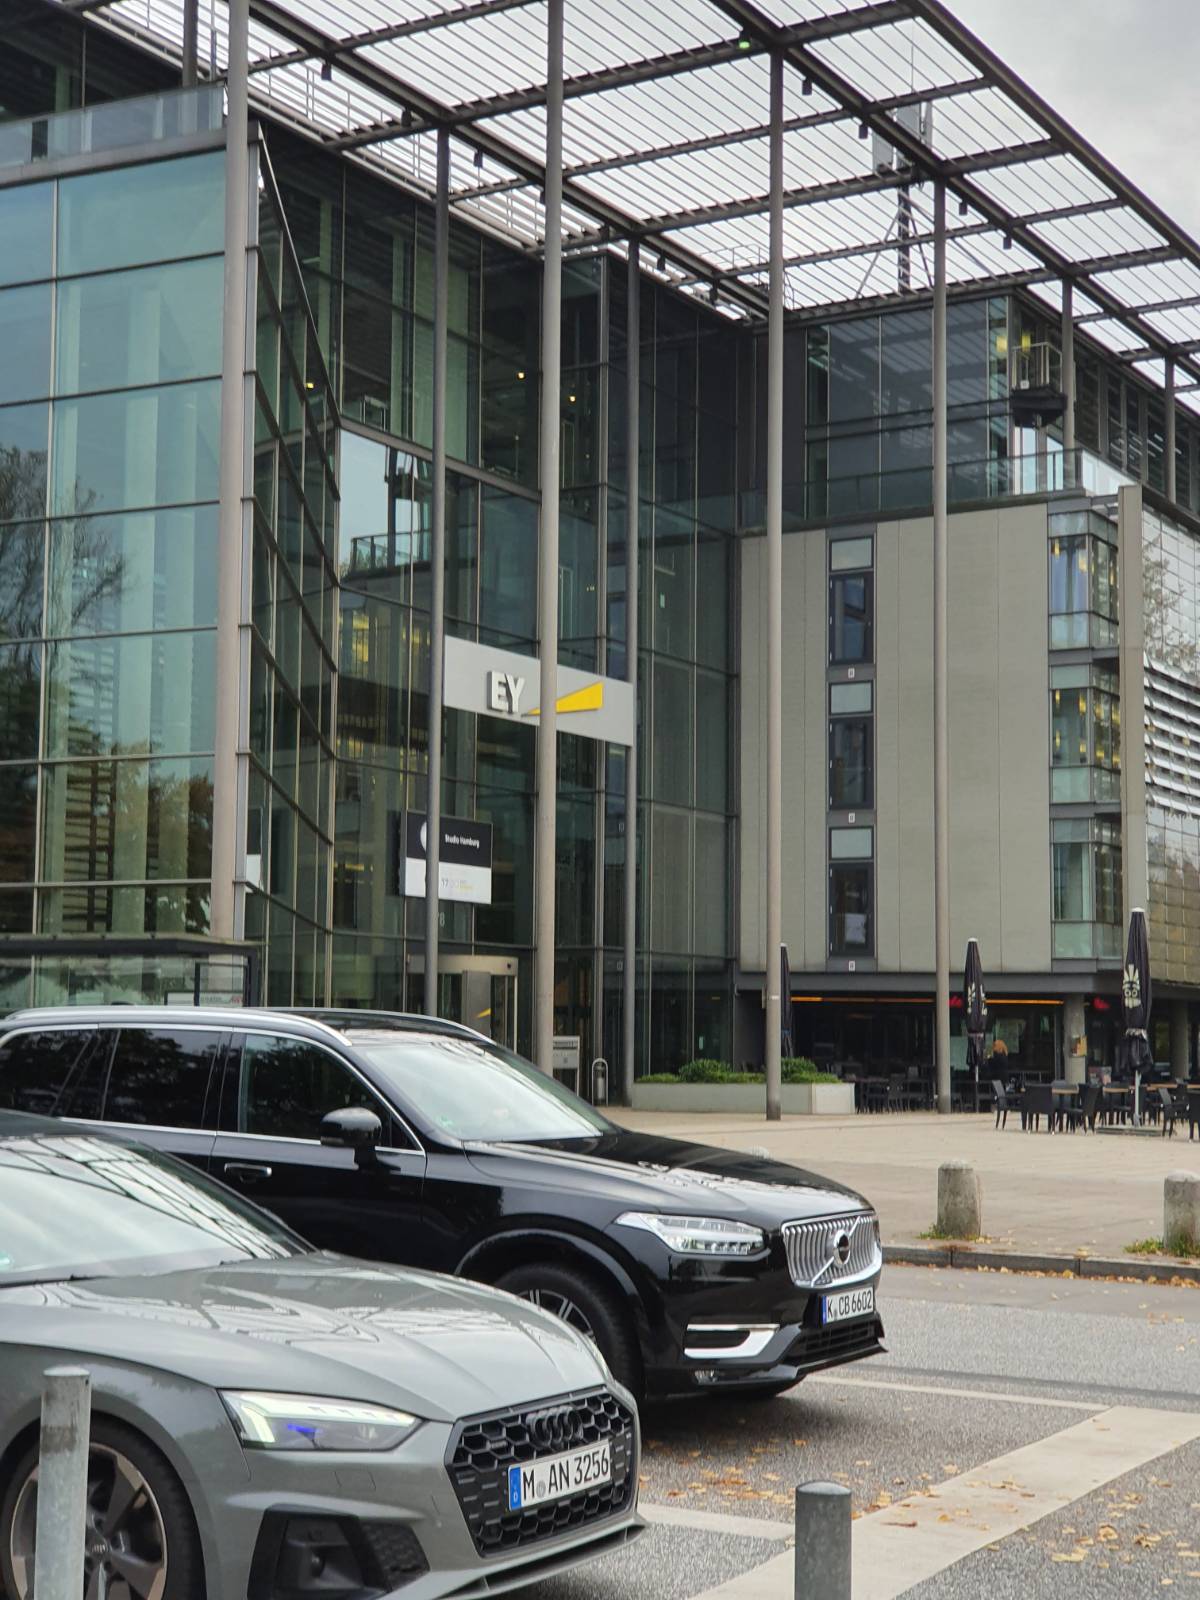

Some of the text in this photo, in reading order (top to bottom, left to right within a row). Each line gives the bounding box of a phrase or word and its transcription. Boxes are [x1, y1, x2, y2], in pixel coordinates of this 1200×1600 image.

[488, 670, 525, 714] EY
[445, 833, 480, 849] Studio Hamburg
[827, 1290, 873, 1319] K CB 6602
[522, 1447, 609, 1501] M AN 3256
